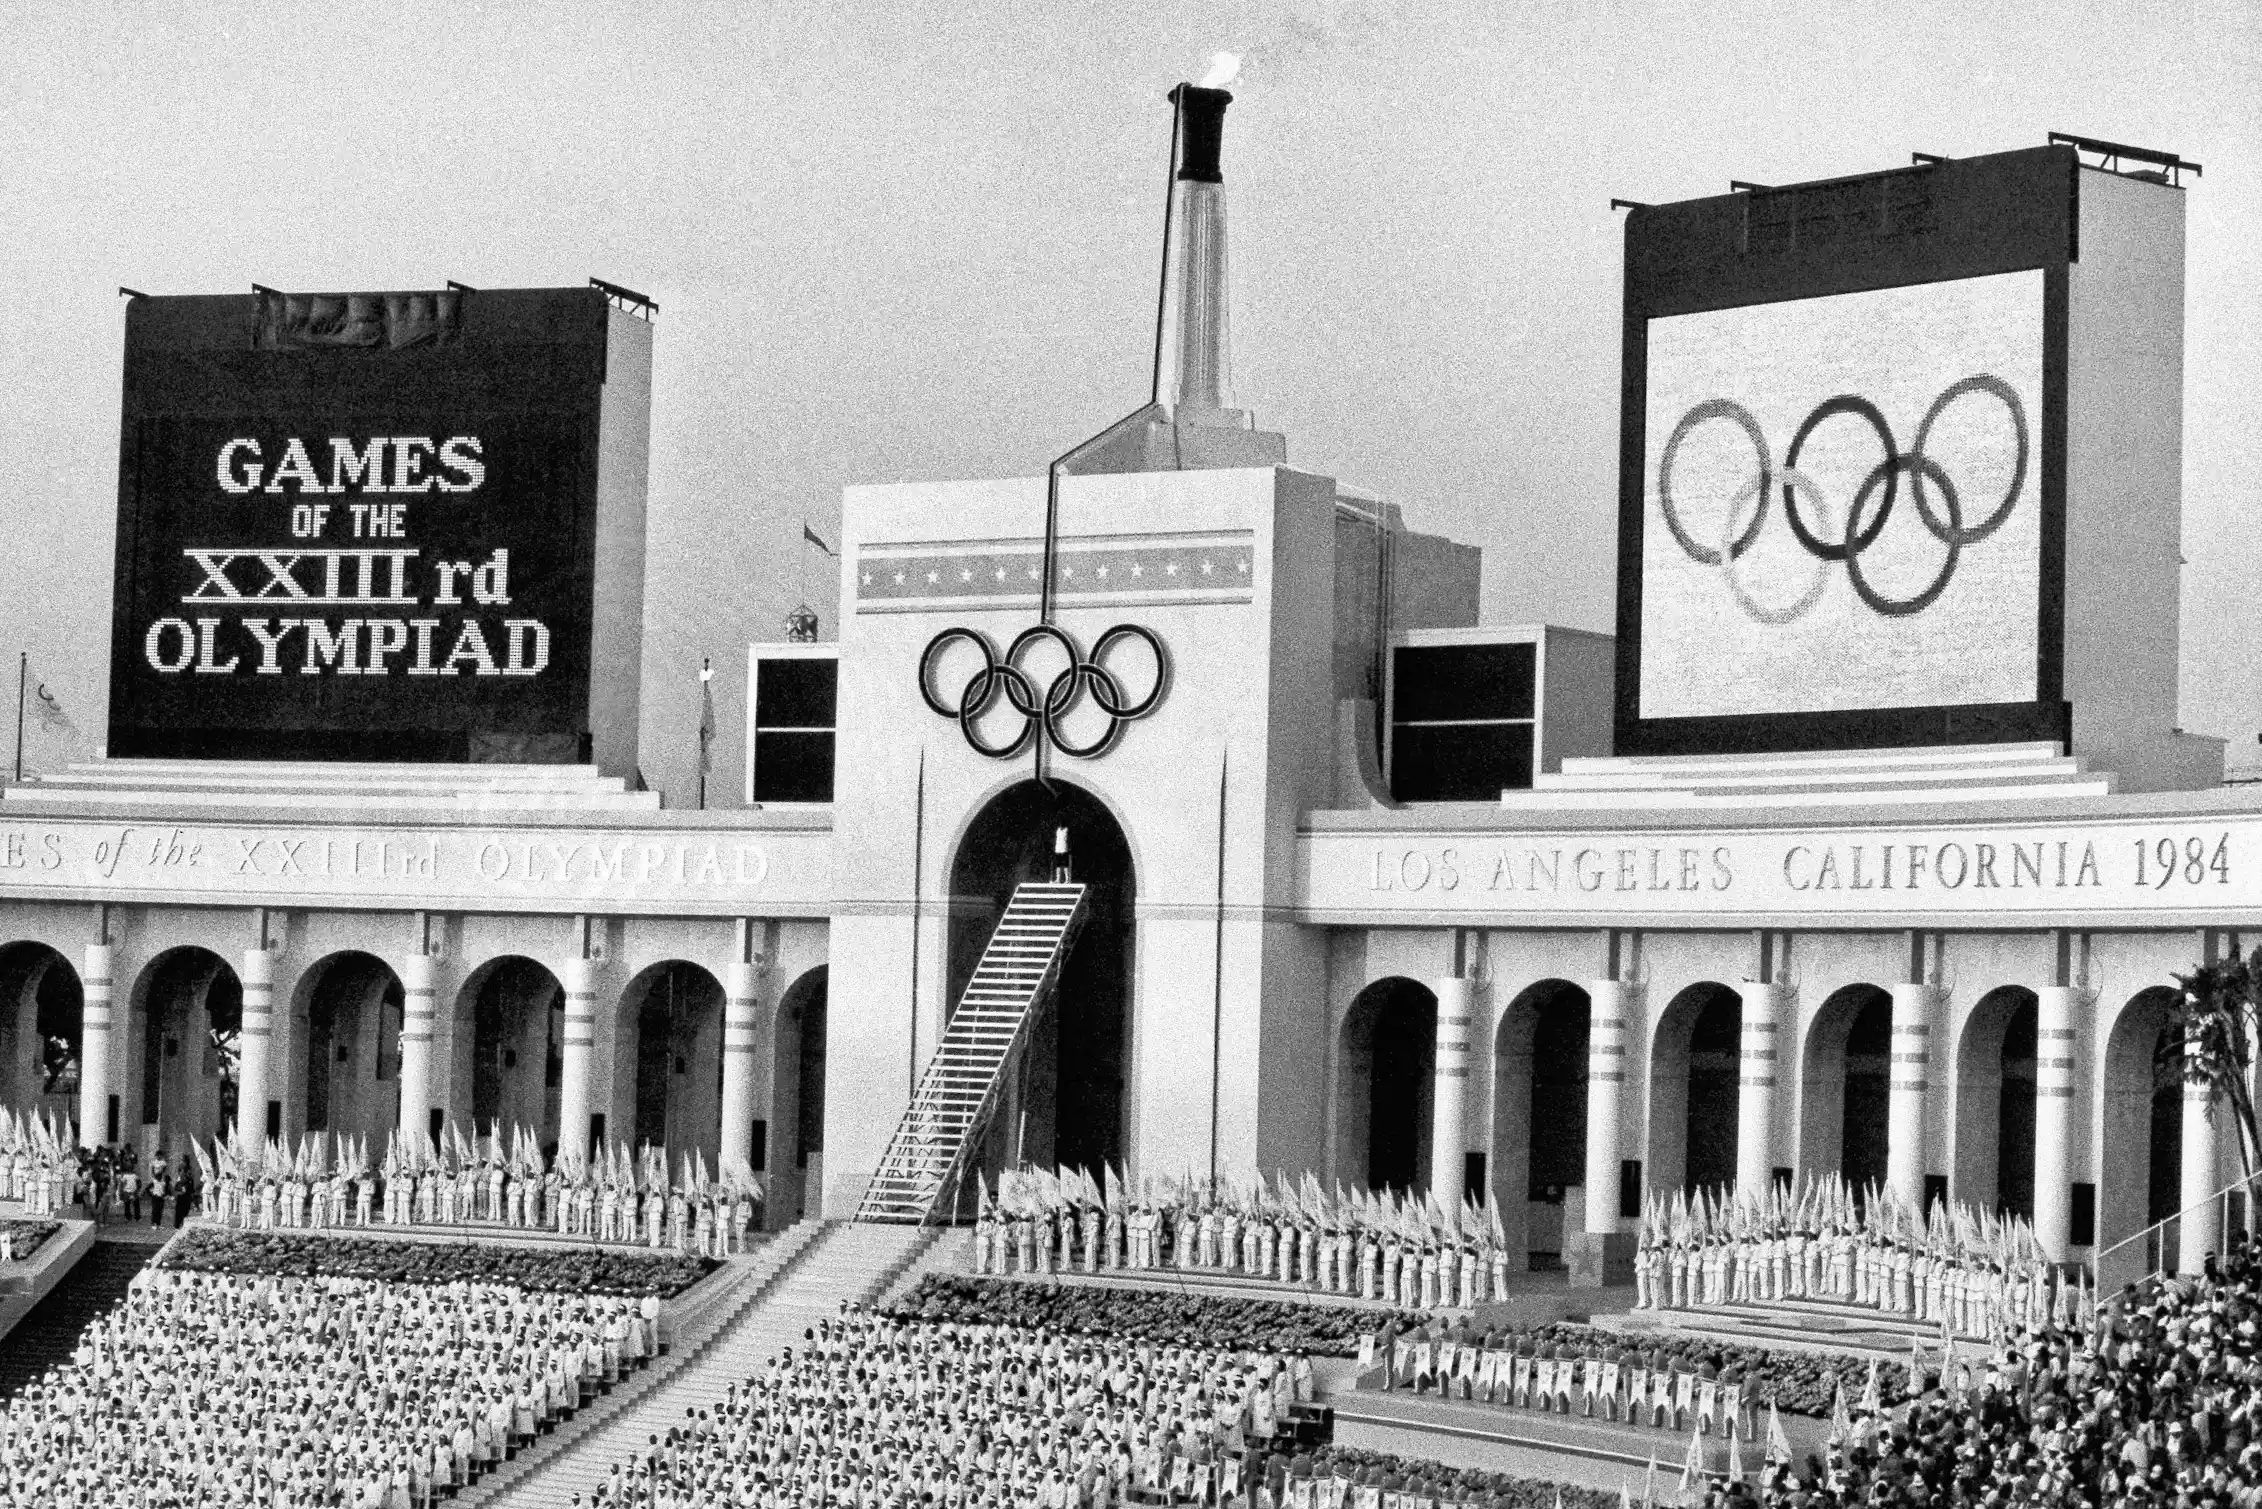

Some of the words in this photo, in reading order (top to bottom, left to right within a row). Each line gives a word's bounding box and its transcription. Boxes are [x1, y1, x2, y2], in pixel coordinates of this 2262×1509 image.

[216, 436, 486, 494] GAMES
[292, 504, 330, 538] OF
[349, 504, 407, 538] THE
[145, 618, 551, 676] OLYMPIAD
[94, 827, 136, 879] of
[148, 829, 203, 867] the
[478, 841, 769, 886] OLYMPIAD
[1369, 848, 1460, 892] LOS
[1487, 846, 1733, 893] ANGELES
[1783, 840, 2103, 891] CALIFORNIA
[2134, 831, 2231, 890] 1984
